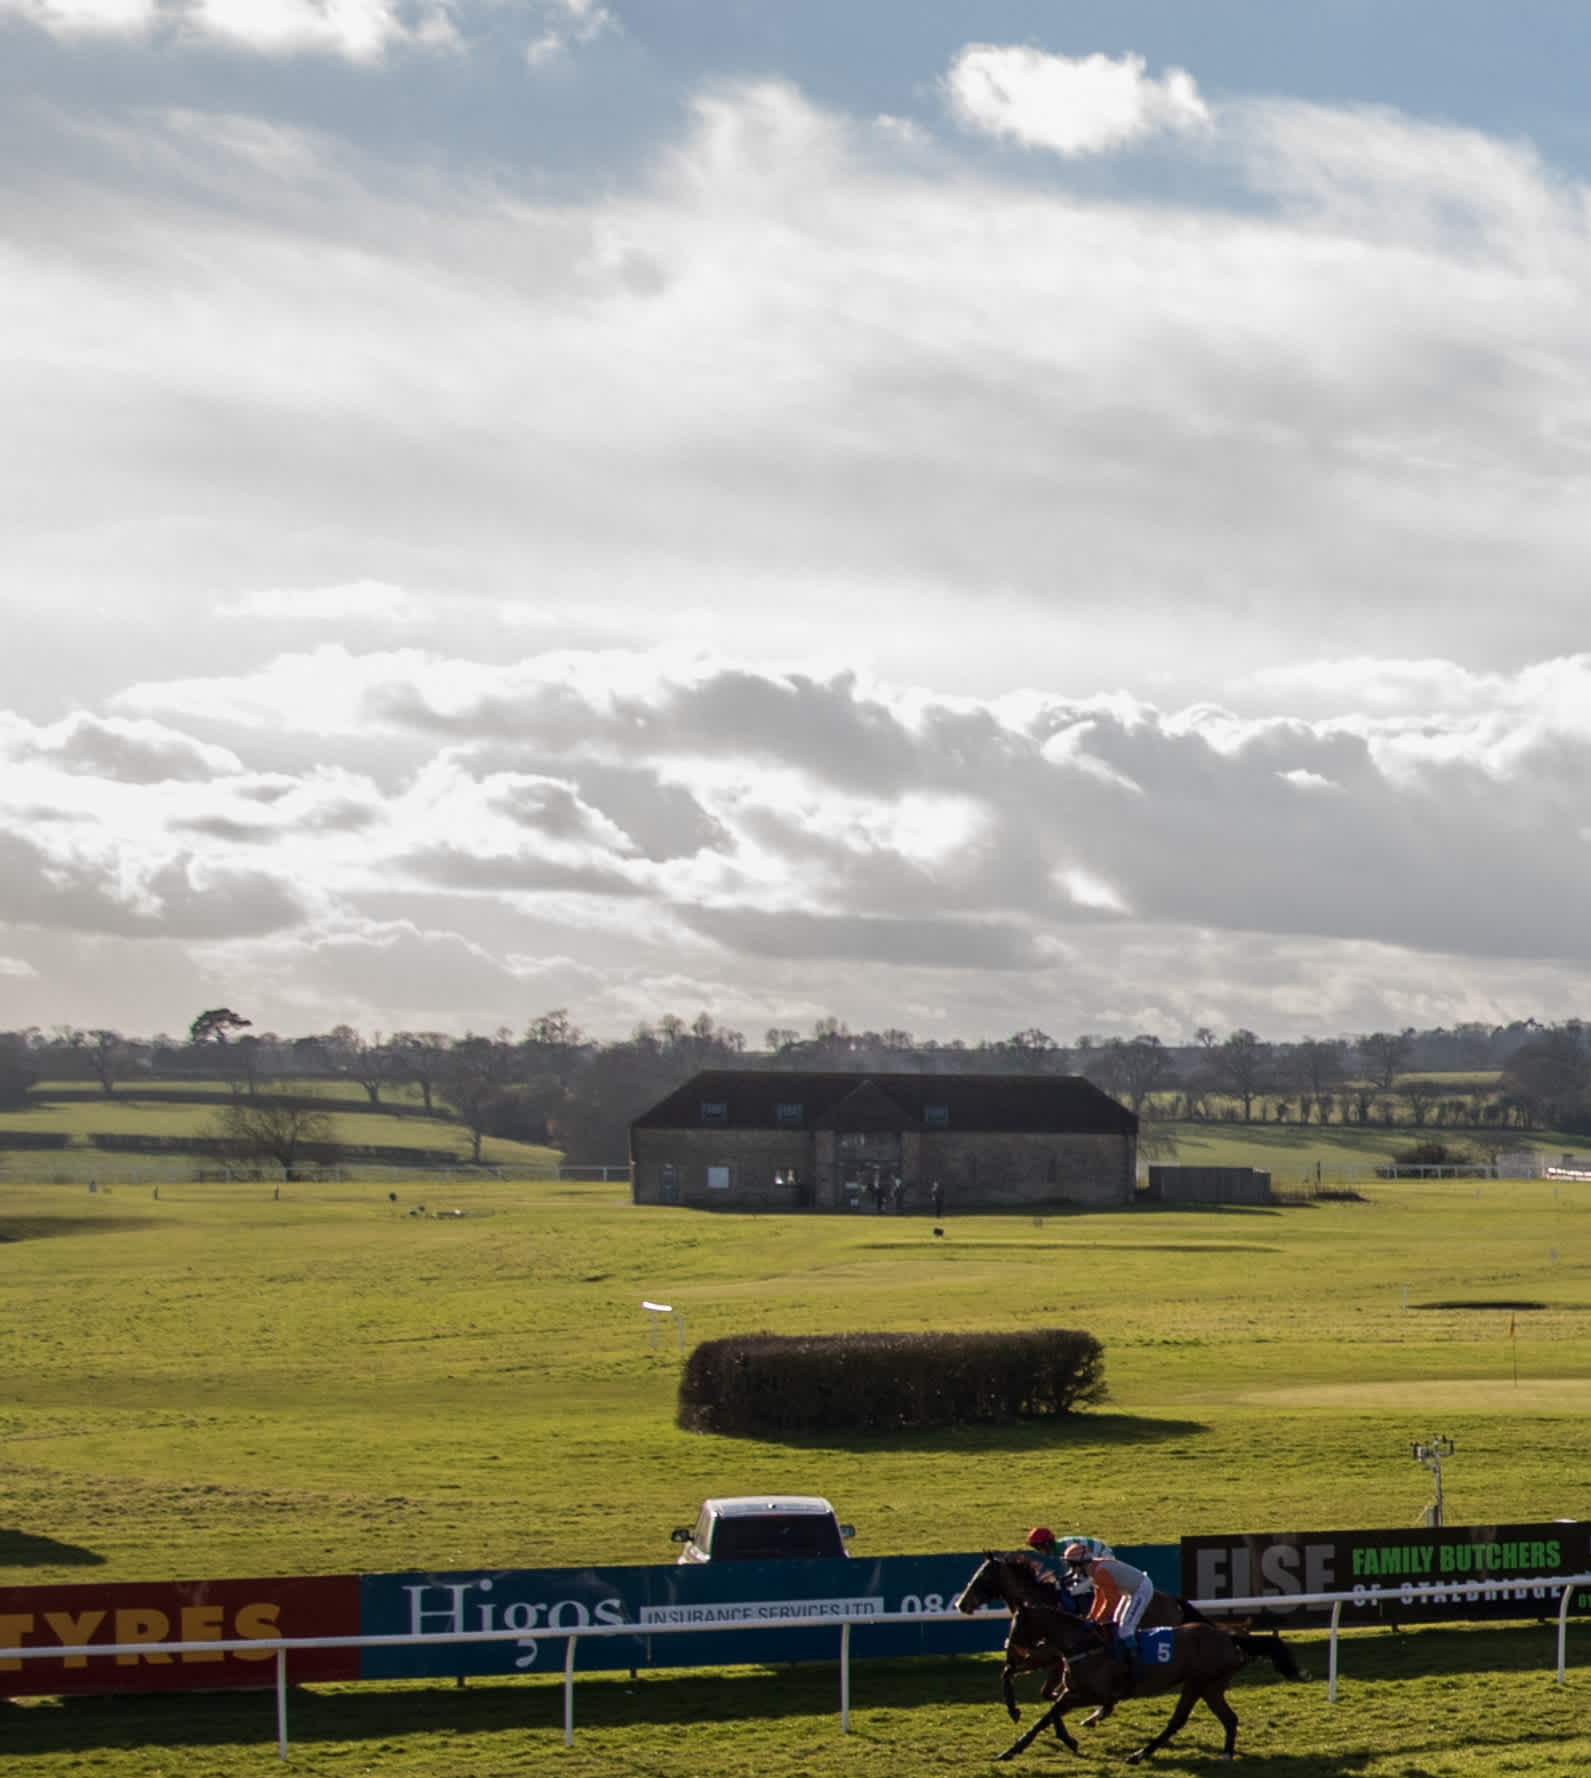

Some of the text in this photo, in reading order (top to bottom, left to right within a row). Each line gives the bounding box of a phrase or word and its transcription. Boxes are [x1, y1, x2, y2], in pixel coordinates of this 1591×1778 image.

[1352, 1540, 1561, 1575] FAMILY BUTCHERS
[0, 1602, 283, 1671] TYRES
[401, 1578, 626, 1668] Higos
[1157, 1642, 1171, 1662] 5
